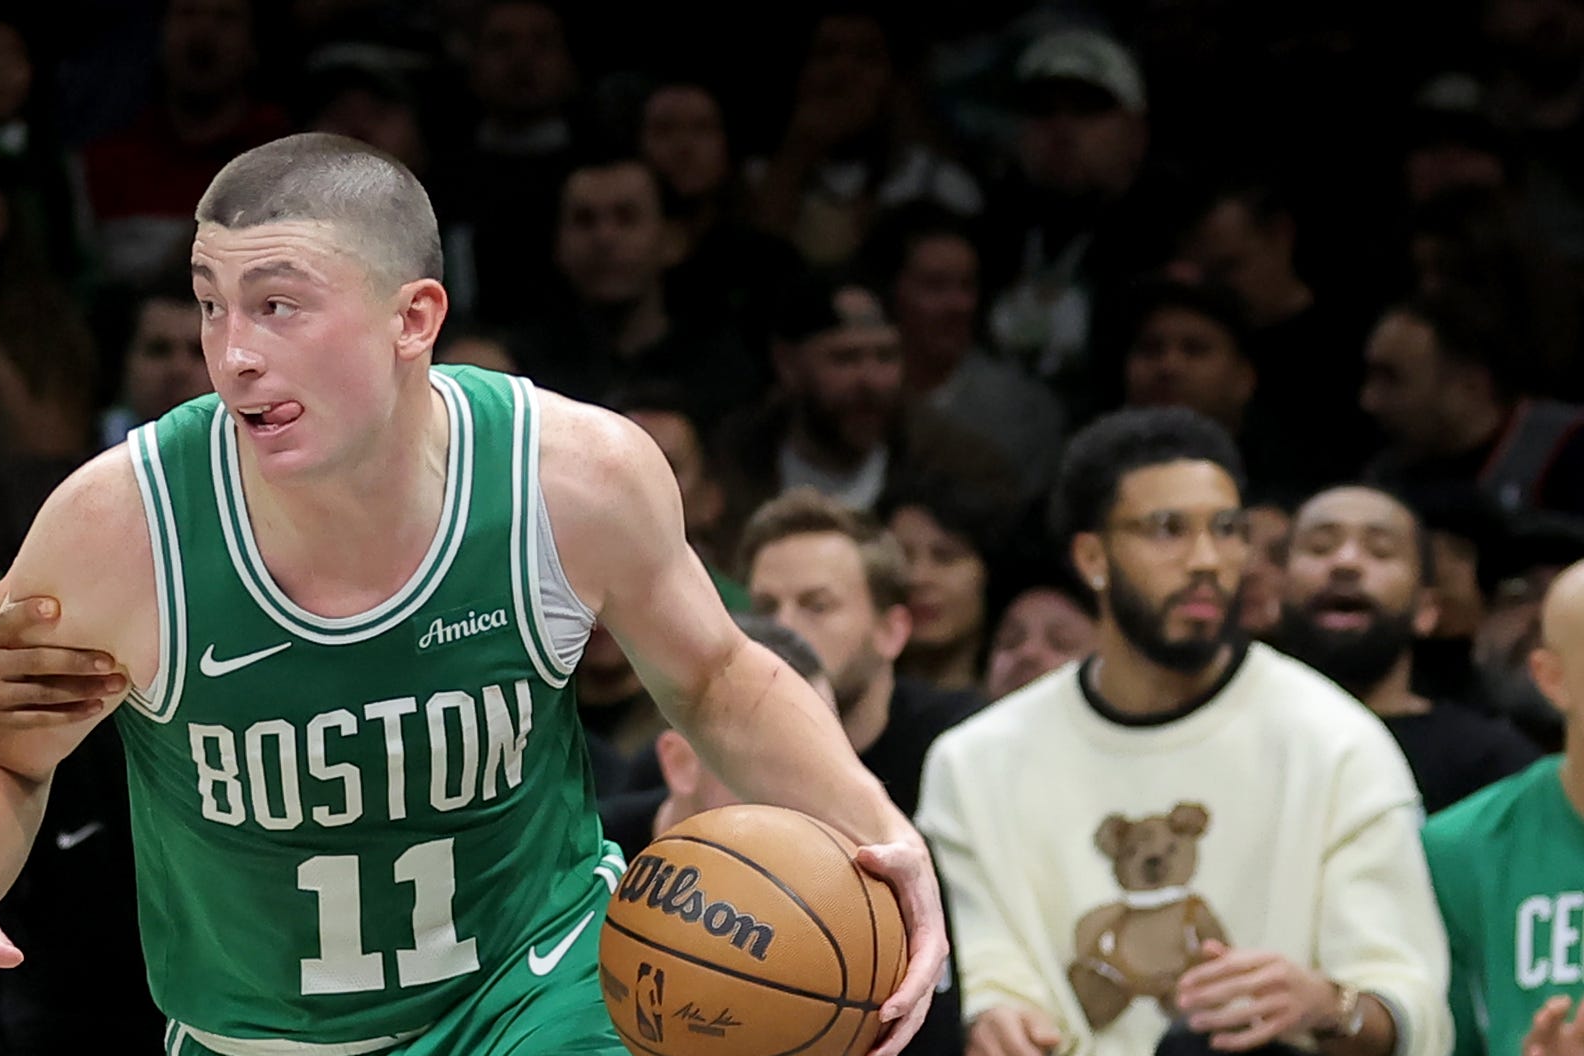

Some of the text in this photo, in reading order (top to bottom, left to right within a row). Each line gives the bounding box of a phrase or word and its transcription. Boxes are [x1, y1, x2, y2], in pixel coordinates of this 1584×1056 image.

[418, 608, 508, 649] Amica
[188, 679, 533, 830] BOSTON
[297, 837, 481, 995] 11
[618, 855, 775, 962] Wilson
[1516, 890, 1584, 989] CE
